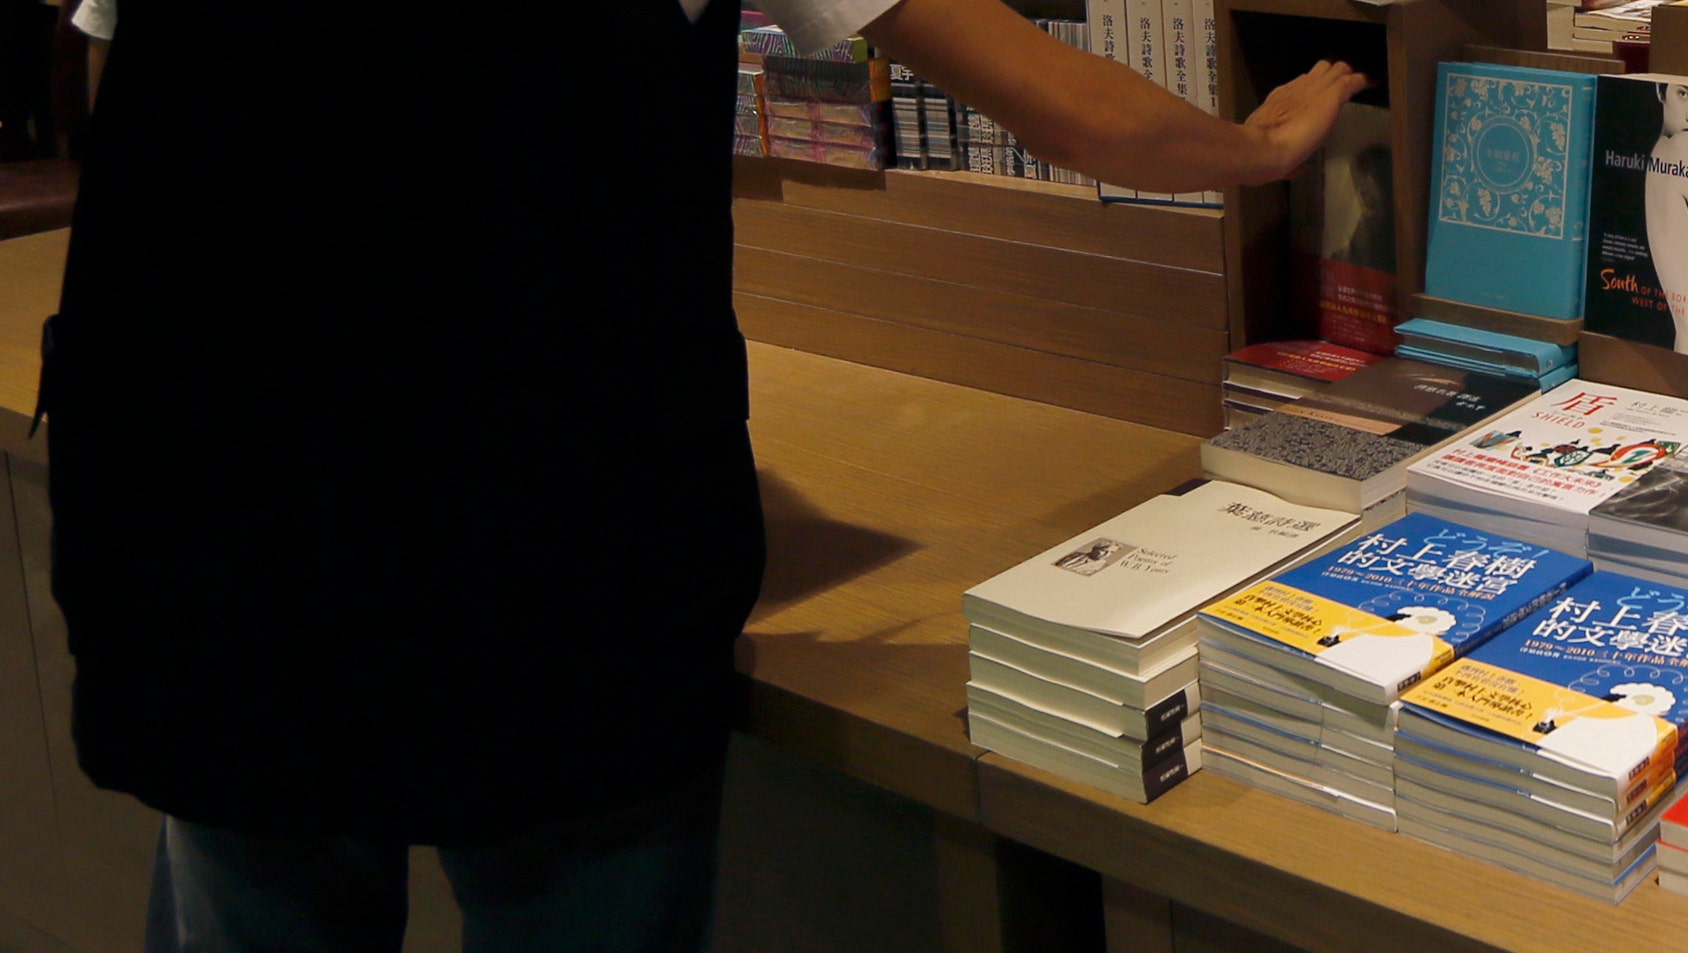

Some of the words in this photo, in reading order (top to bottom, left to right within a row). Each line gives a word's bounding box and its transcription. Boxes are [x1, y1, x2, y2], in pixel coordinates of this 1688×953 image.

[1605, 150, 1645, 171] Haruki
[1600, 268, 1639, 291] South
[1641, 285, 1653, 295] OF
[1654, 288, 1668, 298] THE
[1632, 297, 1653, 307] WEST
[1657, 302, 1668, 311] OF
[1671, 306, 1686, 316] THE
[1551, 392, 1618, 417] 盾
[1531, 411, 1586, 430] SHIELD
[1218, 501, 1322, 532] 葉慈詩選
[1358, 533, 1538, 580] 村上春樹
[1337, 550, 1518, 595] 的文學迷宮
